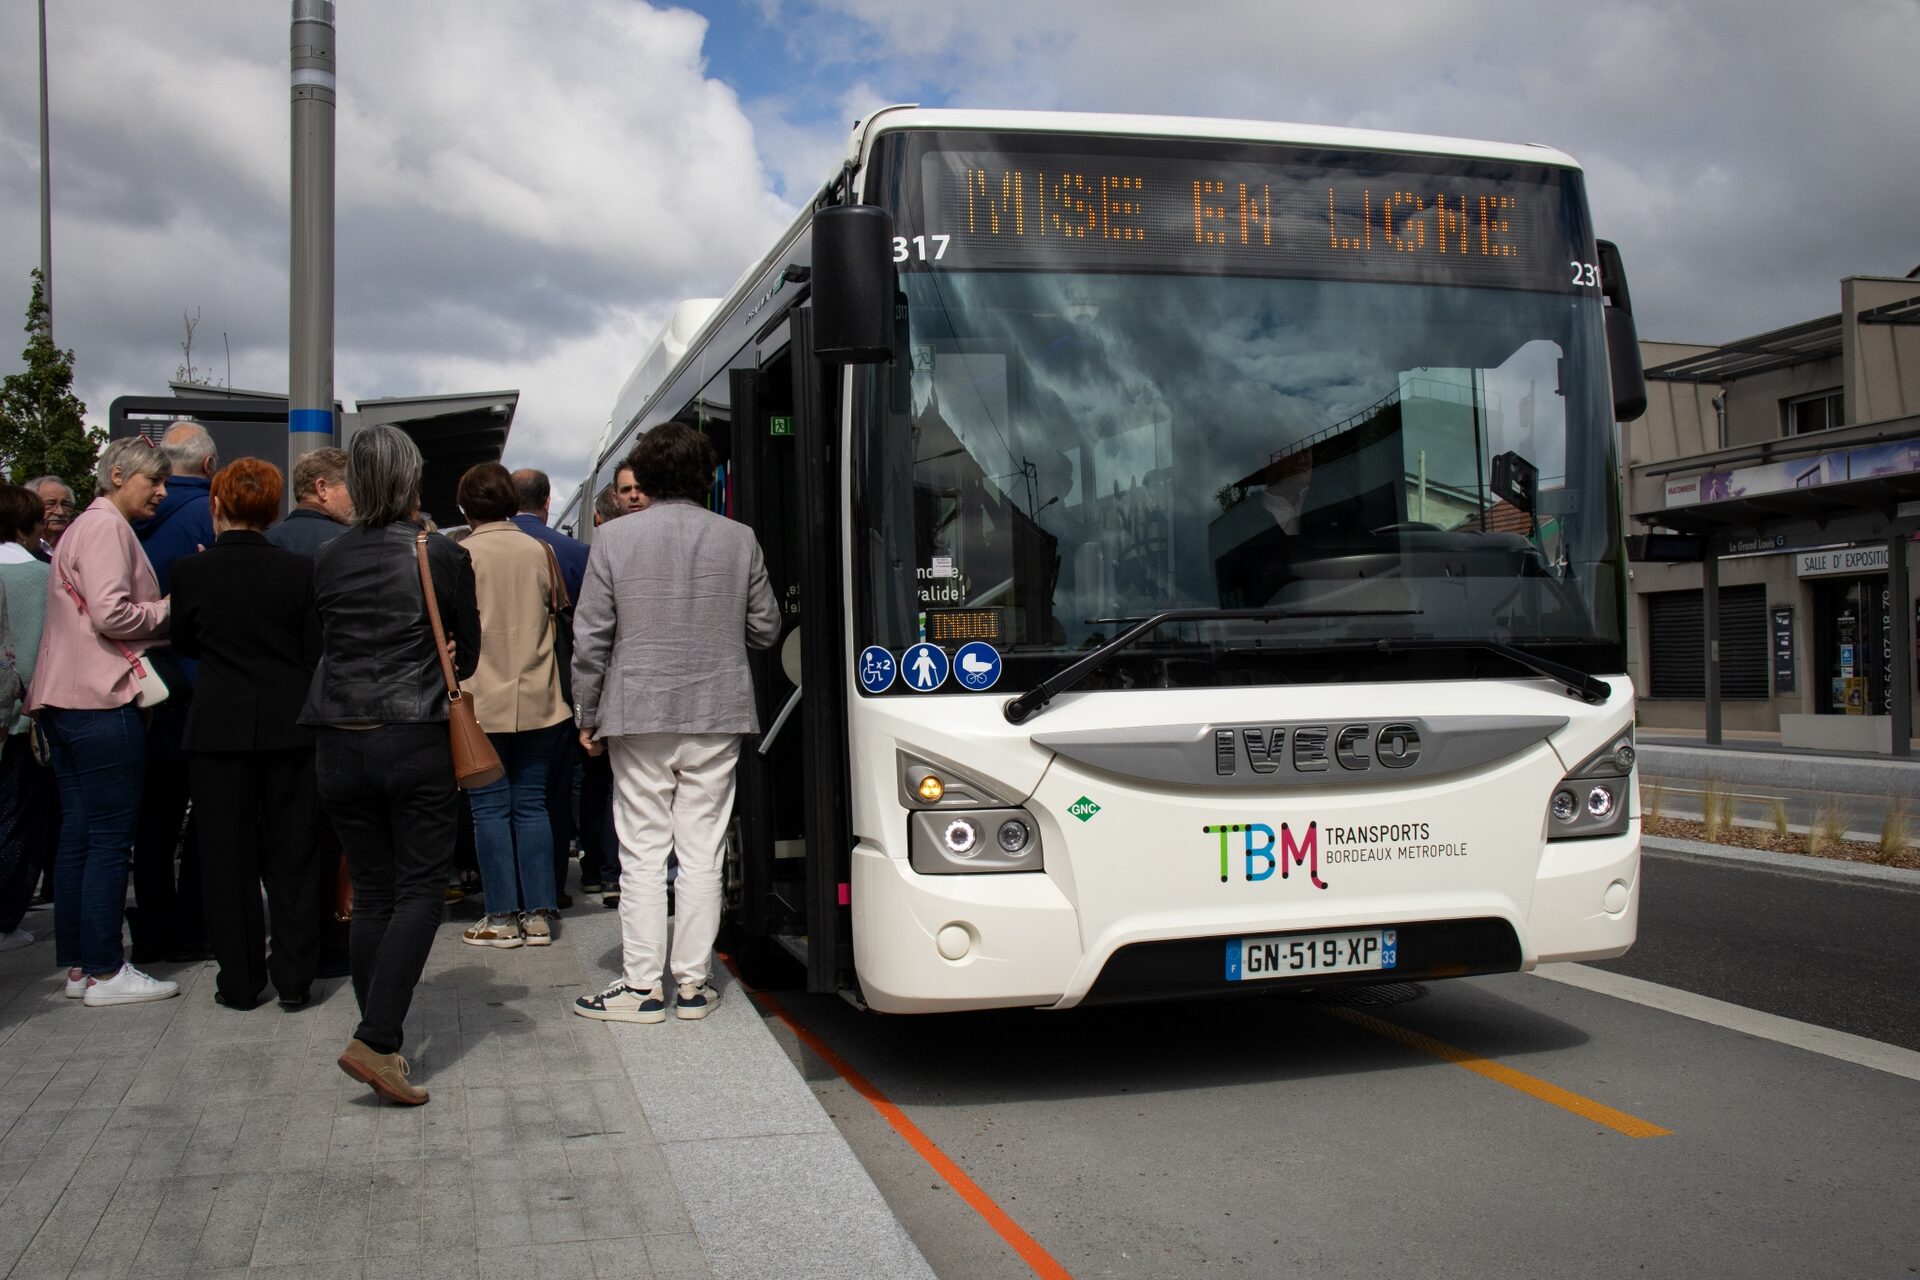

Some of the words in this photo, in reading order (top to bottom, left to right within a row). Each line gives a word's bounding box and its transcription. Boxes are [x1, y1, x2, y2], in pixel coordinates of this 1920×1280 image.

[968, 169, 1145, 240] MISE
[1193, 180, 1271, 246] EN
[1329, 188, 1518, 257] LIGNE
[893, 234, 950, 262] 317
[1804, 556, 1827, 571] SALLE
[876, 659, 891, 671] x2
[1215, 723, 1422, 776] IVECO
[1071, 803, 1097, 815] GNC
[1325, 823, 1430, 845] TRANSPORTS
[1203, 820, 1328, 890] TBM
[1326, 847, 1392, 864] BORDEAUX
[1398, 842, 1468, 860] METROPOLE
[1247, 937, 1377, 973] GN-519-XP
[1382, 950, 1396, 964] 33
[1231, 964, 1236, 973] F
